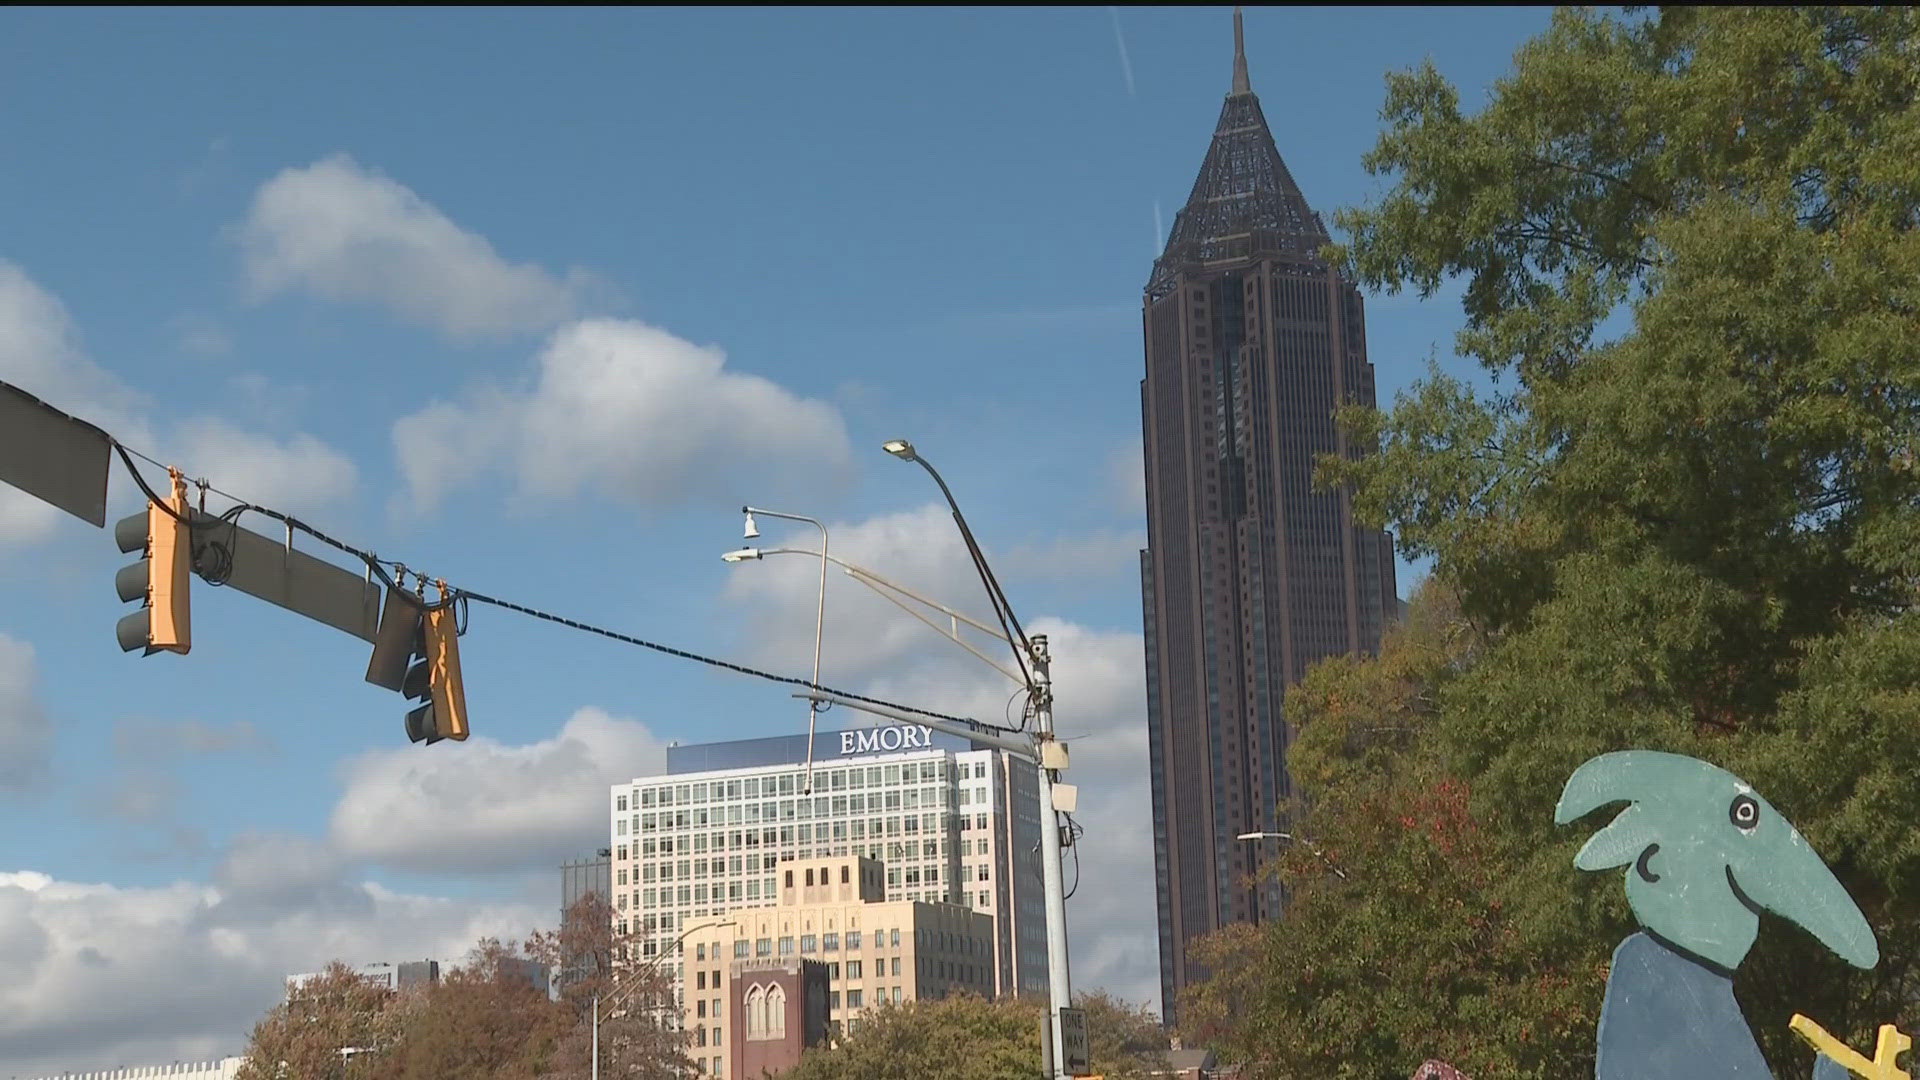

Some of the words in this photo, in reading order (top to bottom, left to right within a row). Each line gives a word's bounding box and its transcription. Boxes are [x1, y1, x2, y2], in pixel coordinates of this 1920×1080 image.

[840, 725, 933, 755] EMORY
[1065, 1013, 1084, 1029] ONE
[1066, 1034, 1084, 1049] WAY
